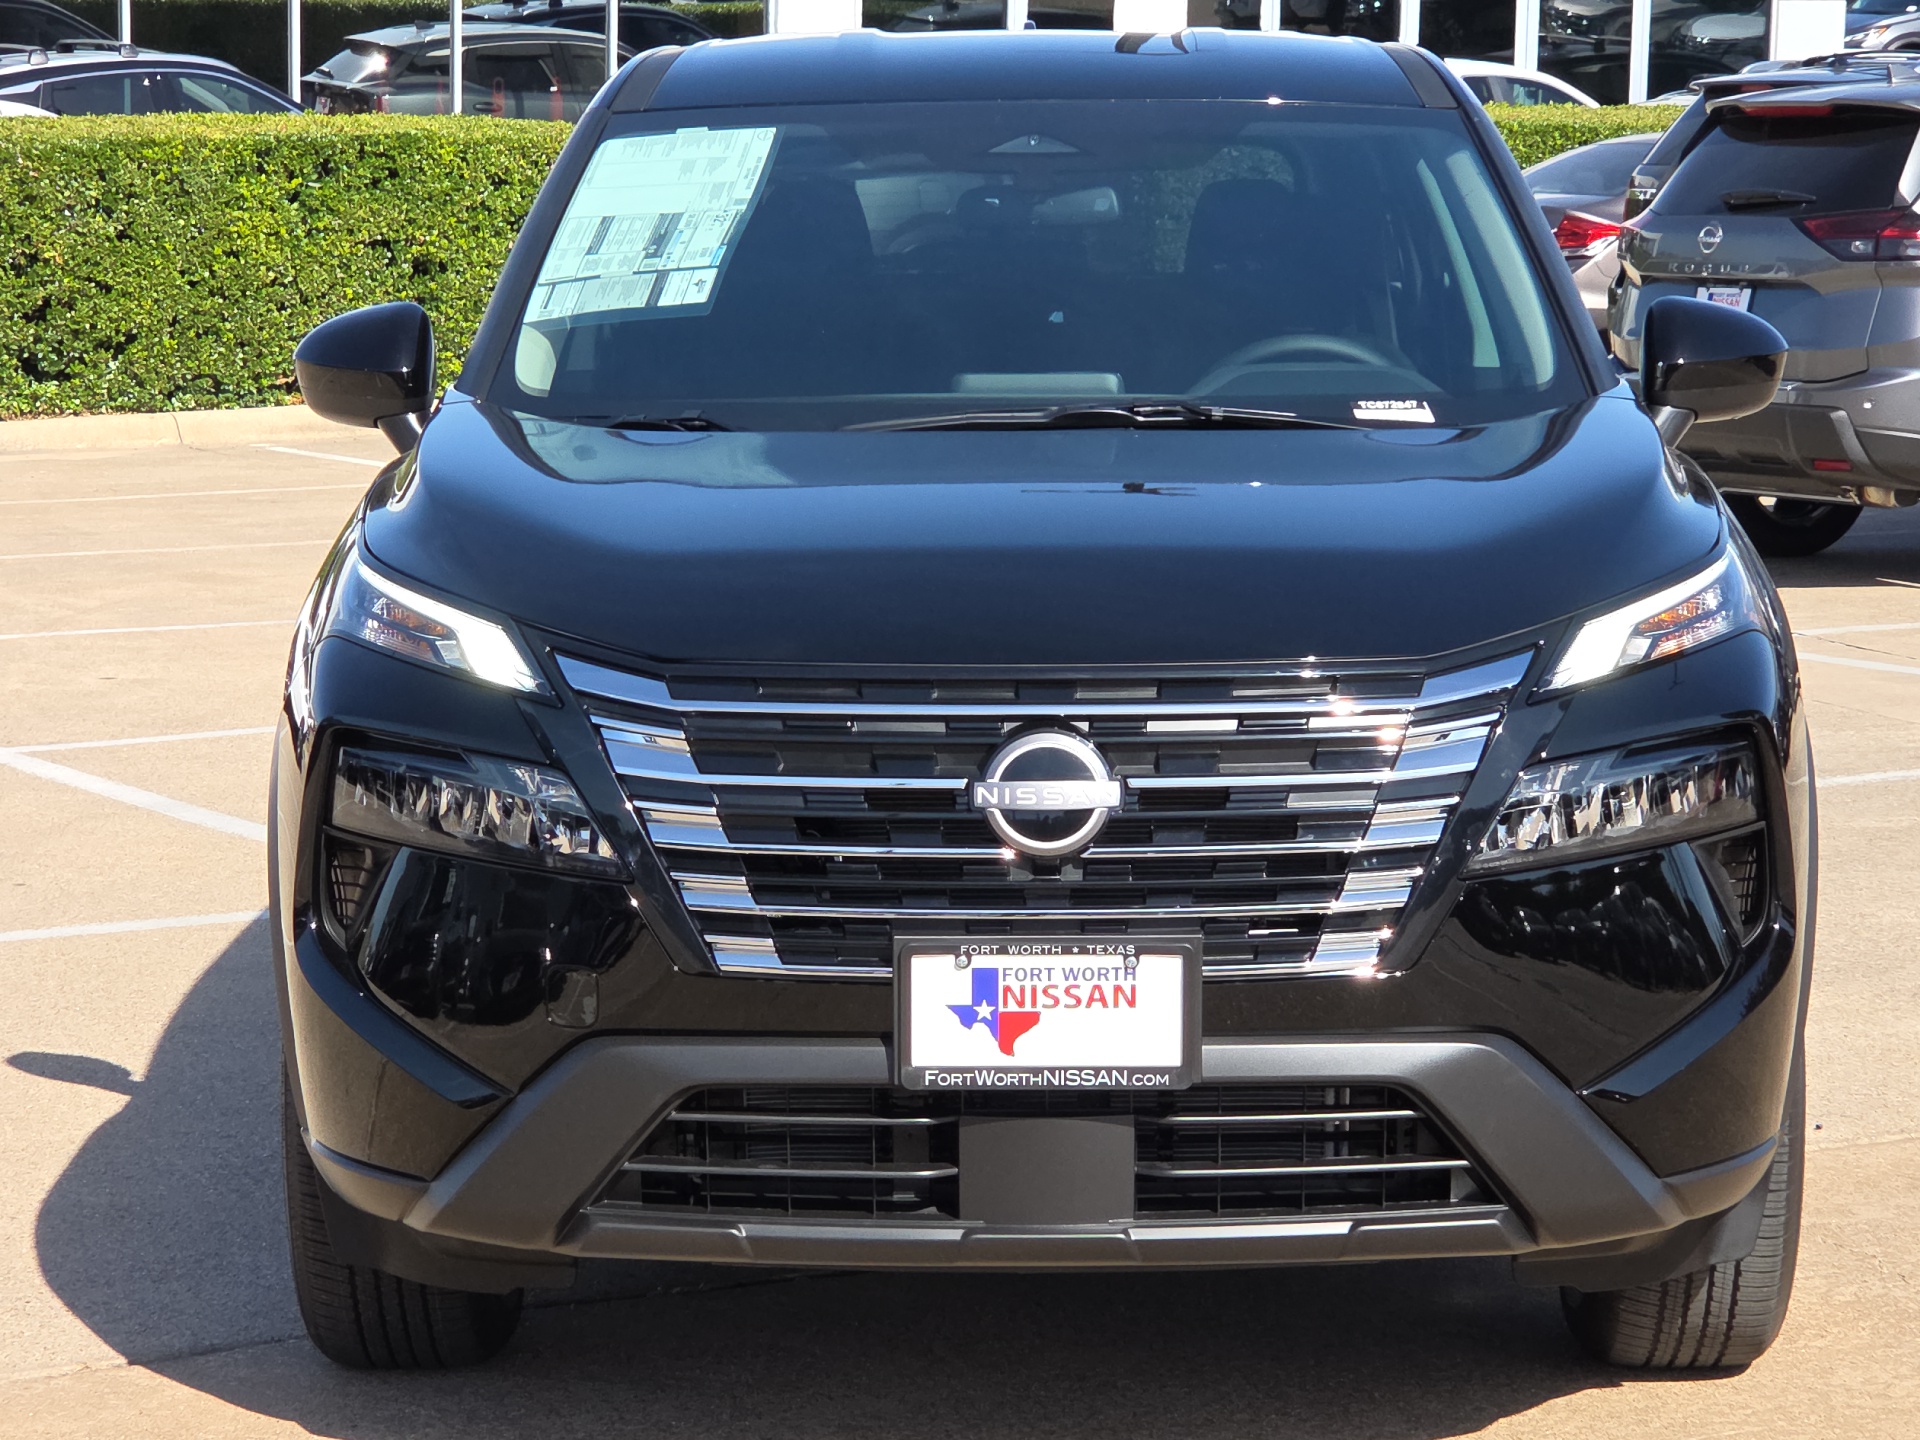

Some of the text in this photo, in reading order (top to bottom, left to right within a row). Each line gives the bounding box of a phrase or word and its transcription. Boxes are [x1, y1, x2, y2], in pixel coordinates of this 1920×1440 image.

[976, 786, 1119, 806] NISSAN
[960, 945, 1136, 955] FORT WORTH TEXAS
[1002, 967, 1137, 982] FORT WORTH
[1002, 984, 1137, 1009] NISSAN
